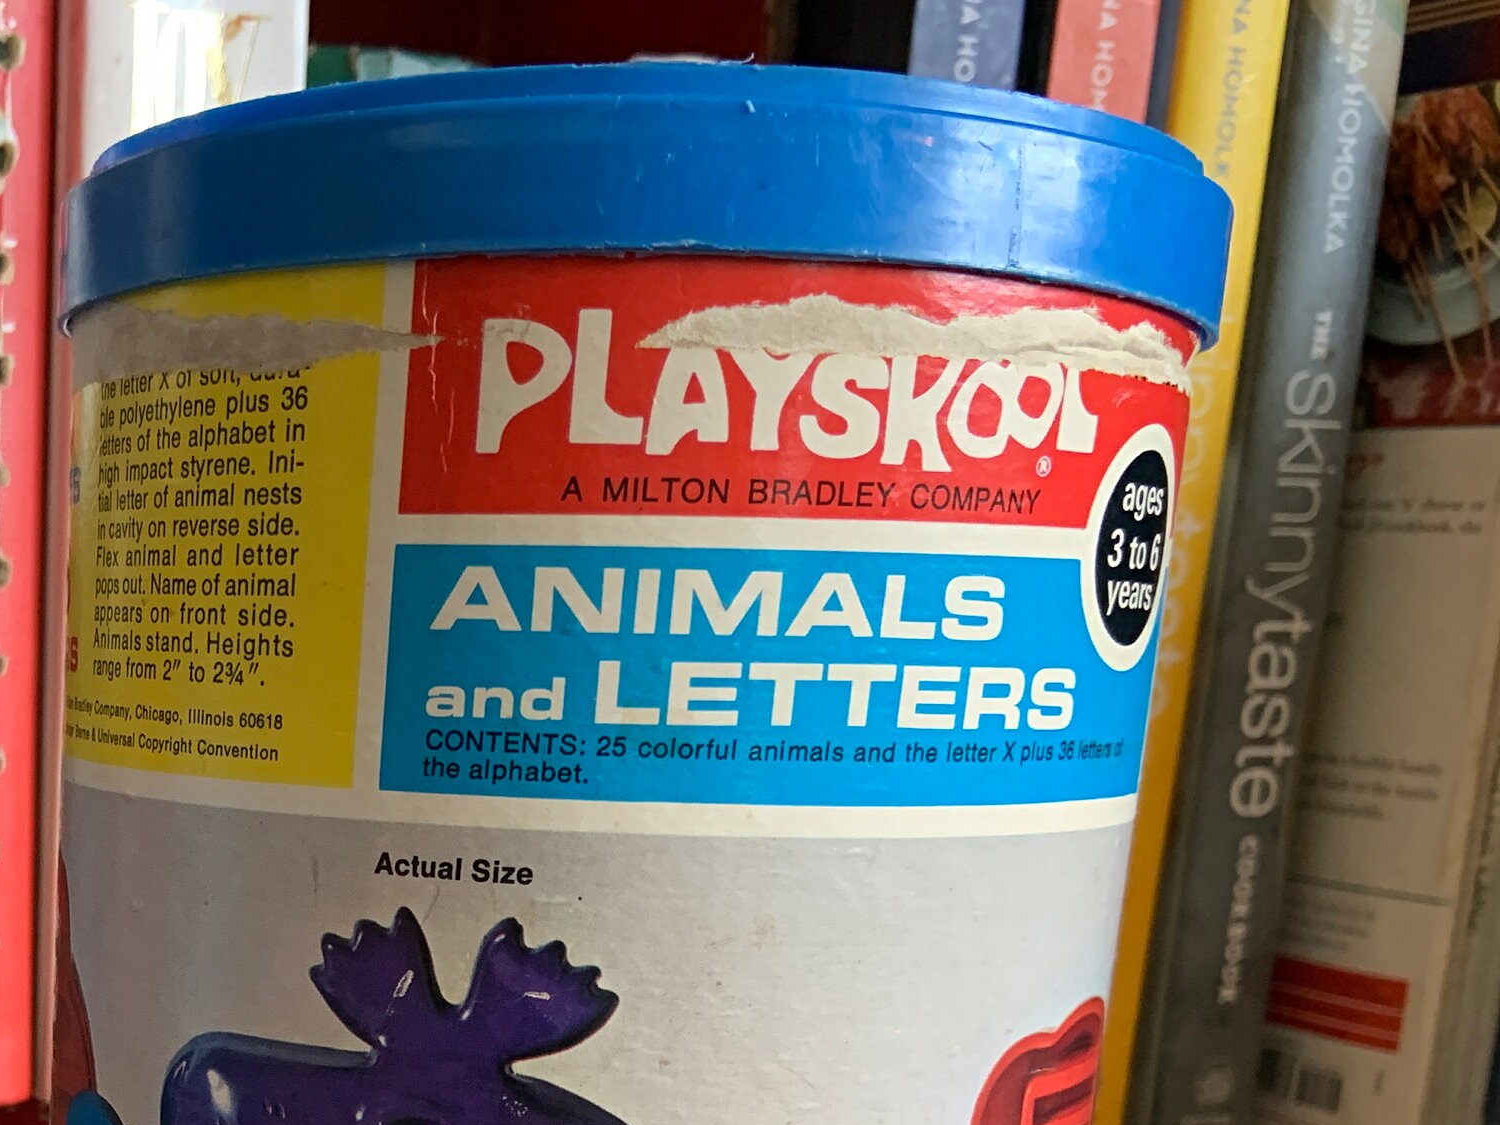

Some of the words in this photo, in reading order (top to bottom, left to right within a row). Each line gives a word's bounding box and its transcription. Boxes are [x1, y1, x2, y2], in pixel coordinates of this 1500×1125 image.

[1323, 83, 1366, 254] HOMOLKA
[119, 396, 216, 431] polyethylene
[226, 390, 270, 420] plus
[281, 386, 309, 411] 36
[137, 428, 153, 454] of
[156, 428, 182, 451] the
[188, 419, 276, 451] alphabet
[286, 418, 306, 443] in
[99, 461, 121, 488] high
[125, 457, 174, 486] impact
[180, 455, 257, 485] styrene.
[269, 449, 306, 475] Ini-
[116, 489, 149, 513] letter
[154, 485, 171, 509] of
[174, 483, 236, 508] animal
[244, 482, 304, 507] nests
[561, 479, 583, 502] A
[602, 480, 731, 507] MILTON
[749, 480, 896, 509] BRADLEY
[910, 482, 1043, 515] COMPANY
[1122, 481, 1165, 521] ages
[97, 521, 107, 541] in
[108, 517, 144, 544] cavity
[148, 520, 167, 539] on
[173, 517, 240, 538] reverse
[248, 514, 301, 538] side.
[96, 546, 120, 568] Flex
[125, 544, 177, 568] animal
[187, 543, 224, 567] and
[236, 543, 300, 567] letter
[1107, 527, 1124, 569] 3
[1129, 535, 1147, 571] to
[1149, 535, 1161, 572] 6
[95, 576, 120, 600] pops
[122, 576, 147, 597] out.
[150, 572, 197, 597] Name
[201, 573, 221, 597] of
[225, 572, 298, 597] animal
[429, 566, 1006, 642] ANIMALS
[1106, 579, 1153, 616] years
[1228, 370, 1343, 818] Skinnytaste
[93, 604, 143, 630] appears
[150, 605, 171, 625] on
[179, 602, 227, 627] front
[238, 603, 296, 629] side.
[93, 629, 142, 653] Animals
[146, 631, 200, 655] stand.
[206, 631, 295, 662] Heights
[92, 657, 122, 683] range
[125, 657, 158, 681] from
[188, 661, 206, 684] to
[425, 676, 566, 722] and
[594, 659, 1078, 731] LETTERS
[93, 699, 134, 722] Company,
[135, 703, 184, 726] Chicago,
[188, 708, 235, 729] Illinois
[238, 713, 284, 731] 60618
[97, 727, 136, 748] Universal
[138, 732, 193, 757] Copyright
[197, 738, 279, 762] Convention
[425, 728, 587, 757] CONTENTS:
[596, 735, 628, 758] 25
[637, 736, 738, 762] colorful
[748, 740, 845, 763] animals
[853, 741, 896, 764] and
[904, 741, 938, 764] the
[946, 741, 997, 764] letter
[1001, 741, 1015, 763] X
[1019, 740, 1054, 767] plus
[1057, 740, 1077, 762] 36
[1077, 739, 1113, 762] letters
[422, 756, 461, 779] the
[468, 758, 589, 785] alphabet.
[374, 851, 463, 882] Actual
[471, 858, 534, 886] Size
